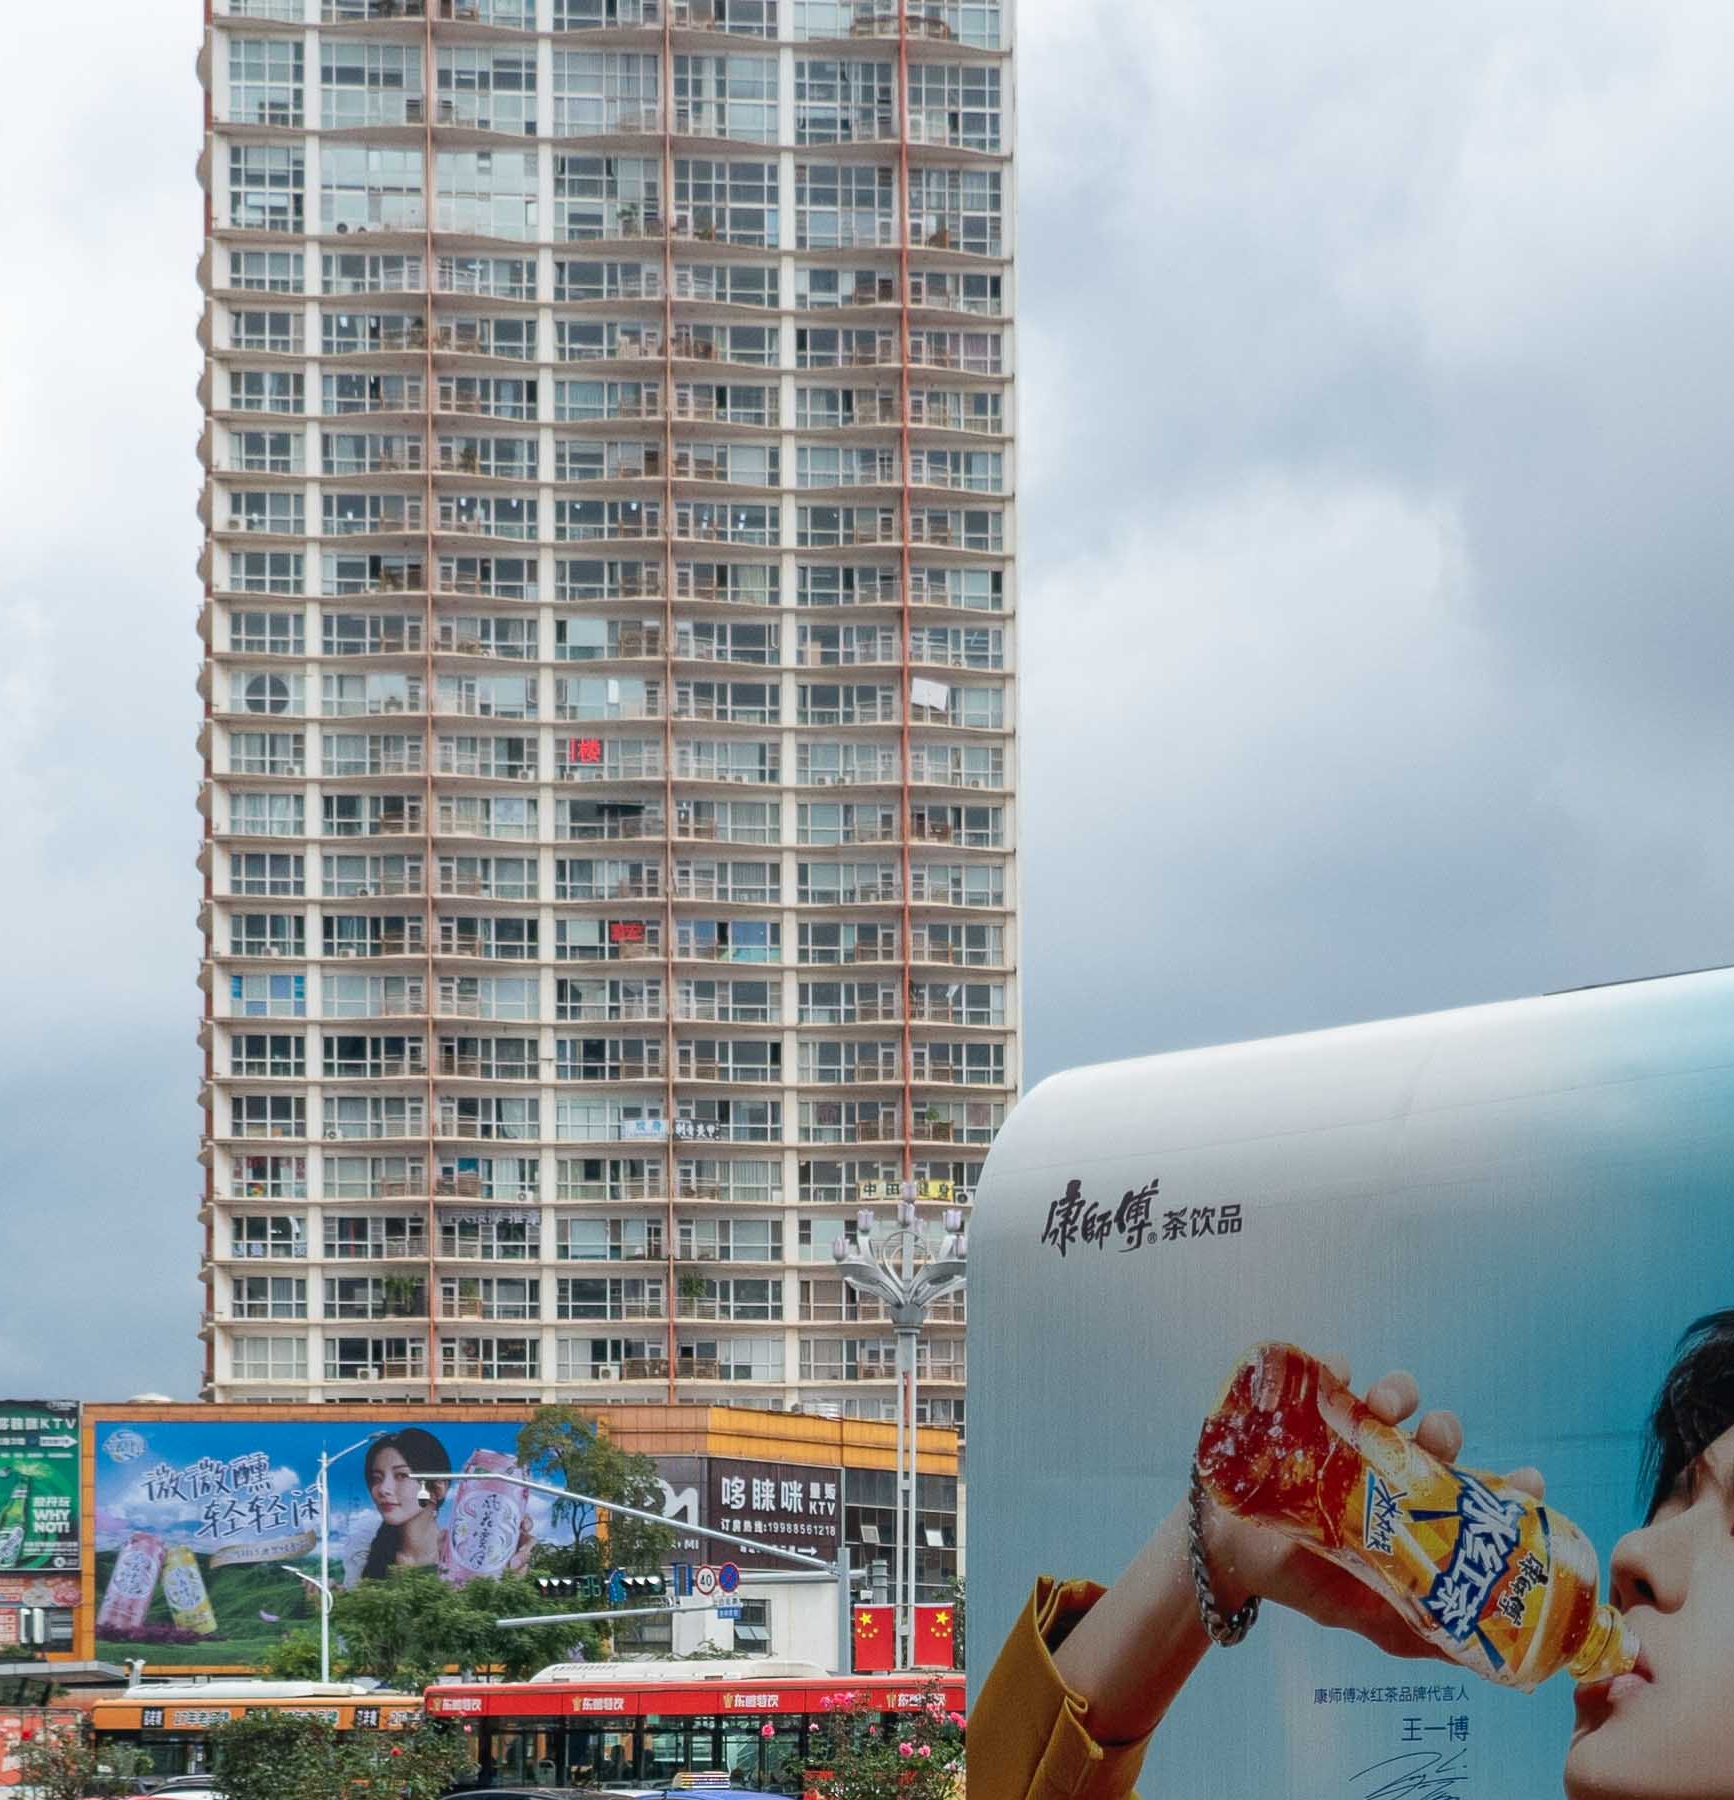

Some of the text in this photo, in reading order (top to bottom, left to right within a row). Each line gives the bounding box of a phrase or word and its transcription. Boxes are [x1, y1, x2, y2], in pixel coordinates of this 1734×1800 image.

[1162, 1203, 1243, 1240] 茶饮品
[33, 1509, 71, 1521] WHY
[809, 1501, 836, 1516] KTV
[33, 1522, 70, 1533] NOT!
[699, 1574, 713, 1587] 40
[1313, 1684, 1470, 1705] 康师傅冰红茶品牌代言人
[1401, 1715, 1470, 1742] 王一博
